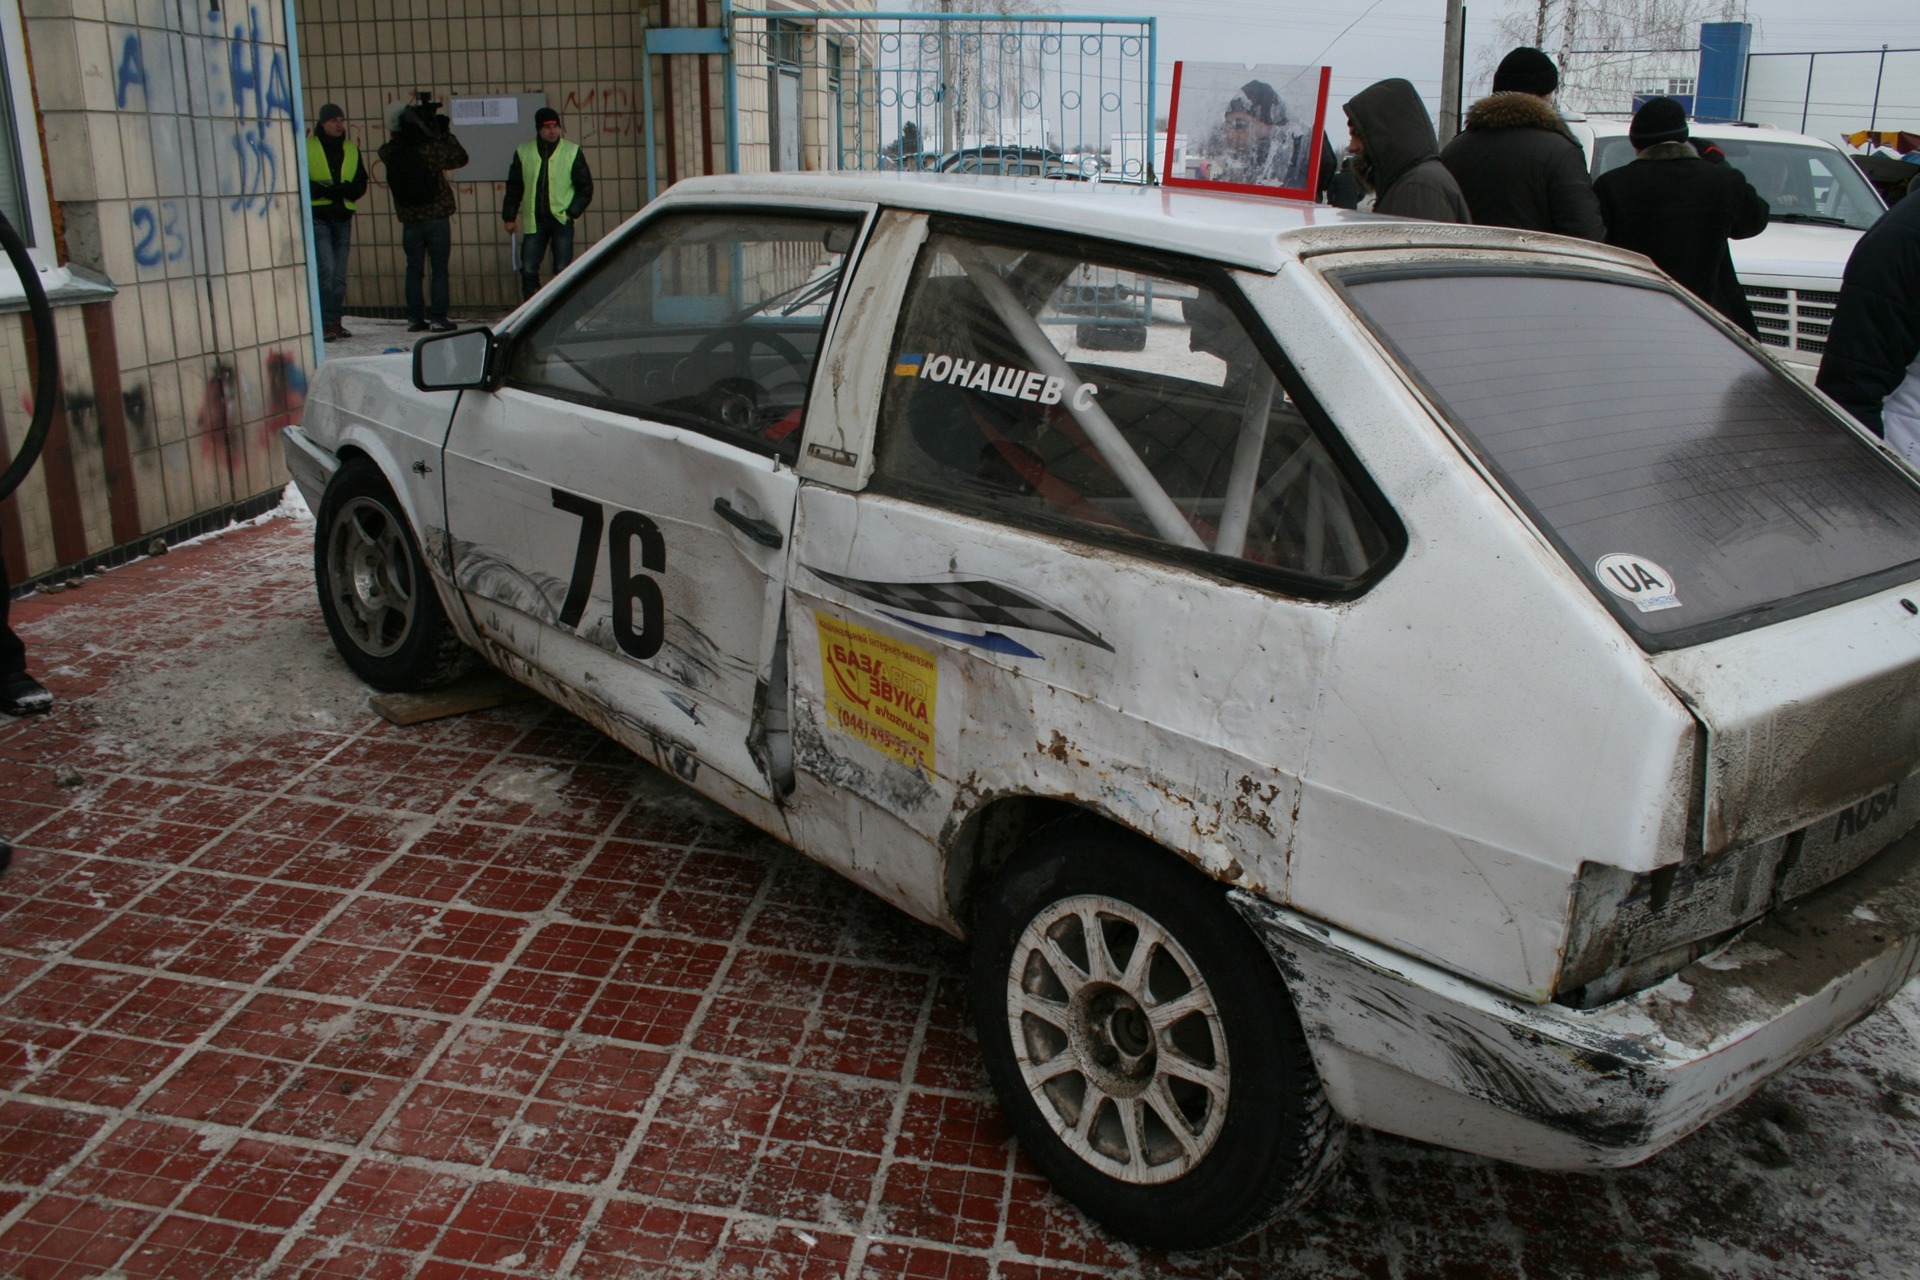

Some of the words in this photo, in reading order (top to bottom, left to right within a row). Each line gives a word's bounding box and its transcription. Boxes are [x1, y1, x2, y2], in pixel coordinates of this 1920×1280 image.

[920, 352, 1066, 405] ЮНАШЕВ
[1072, 382, 1099, 412] С
[550, 487, 667, 660] 76
[1606, 563, 1664, 593] UA
[833, 643, 887, 682] БАЗА
[869, 675, 929, 725] ЗВУКА
[874, 704, 930, 744] avtozvuk.ua
